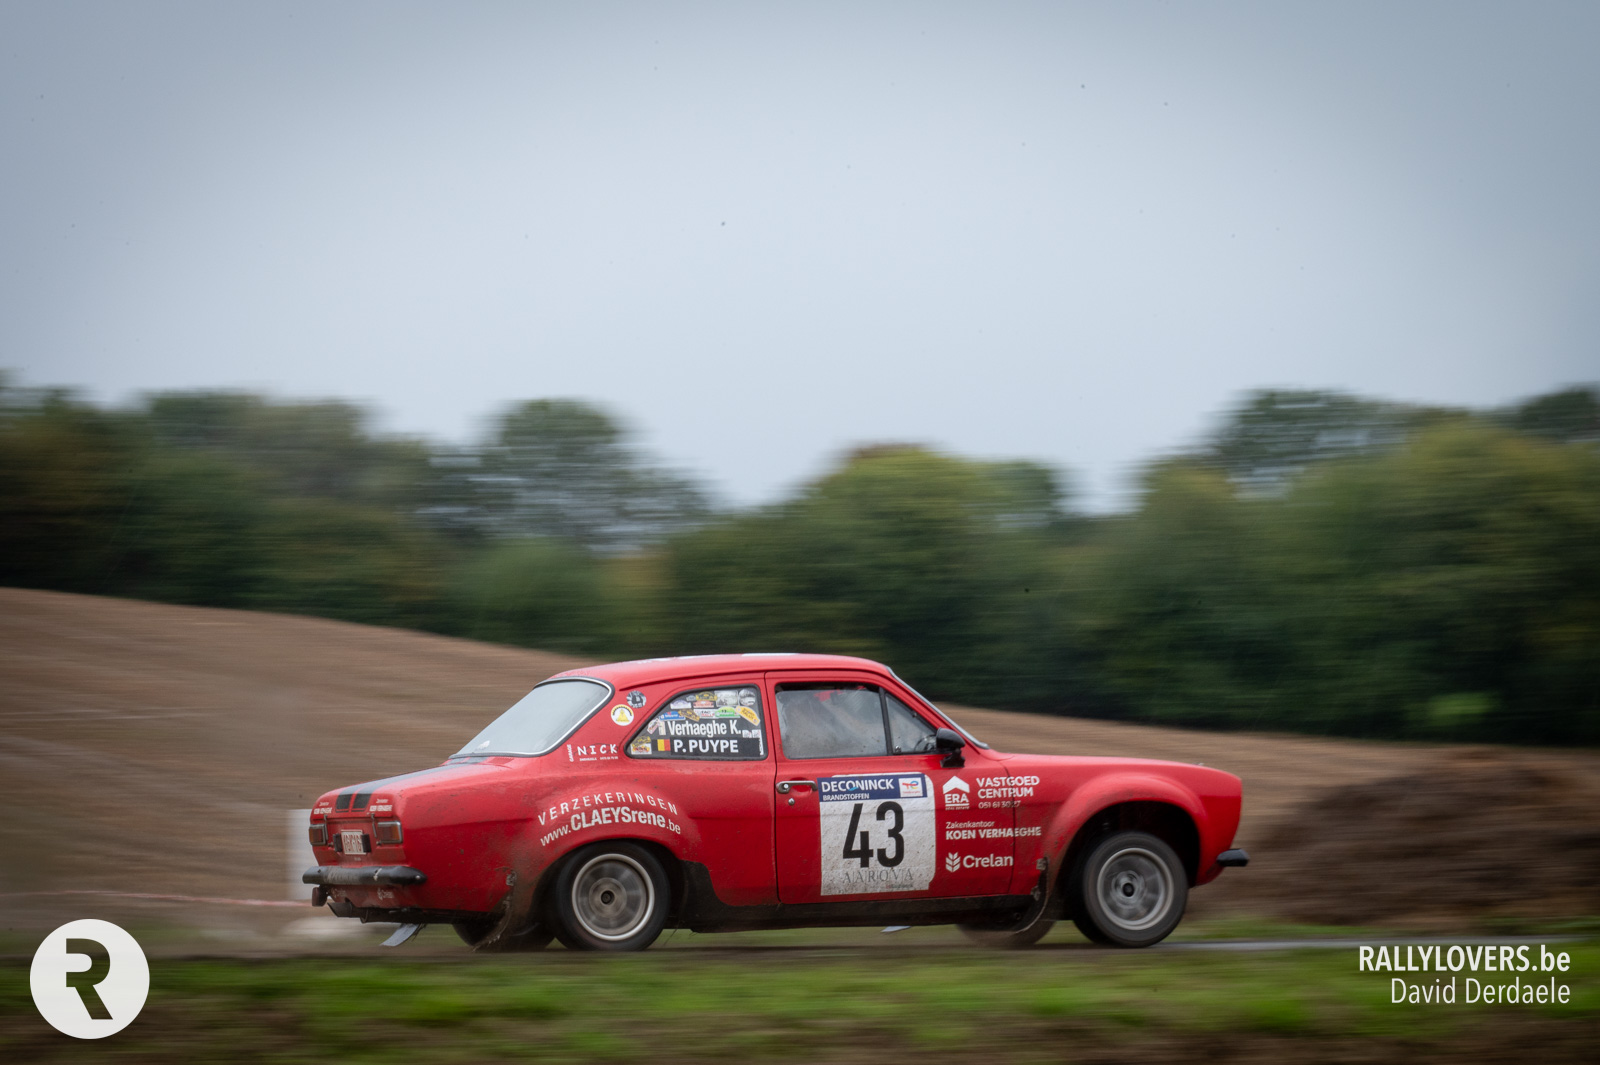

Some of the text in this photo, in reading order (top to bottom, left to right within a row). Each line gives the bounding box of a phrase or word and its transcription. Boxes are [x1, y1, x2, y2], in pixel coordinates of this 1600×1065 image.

[667, 720, 727, 738] Verhaeghe
[729, 719, 741, 735] K.
[577, 744, 617, 756] NICK
[821, 778, 895, 793] DECONINCK
[976, 775, 1040, 787] VASTGOED
[822, 793, 870, 801] BRANDSTOFFEN
[944, 793, 969, 803] ERA
[977, 787, 1034, 799] CENTRUM
[537, 792, 678, 826] VERZEKERINGEN
[540, 806, 681, 846] www.CLAEYSrene.be
[945, 821, 995, 829] Zakenkantoor
[842, 800, 904, 868] 43
[945, 826, 1042, 840] KOEN VERHAEGHE
[963, 853, 1014, 868] Crelan
